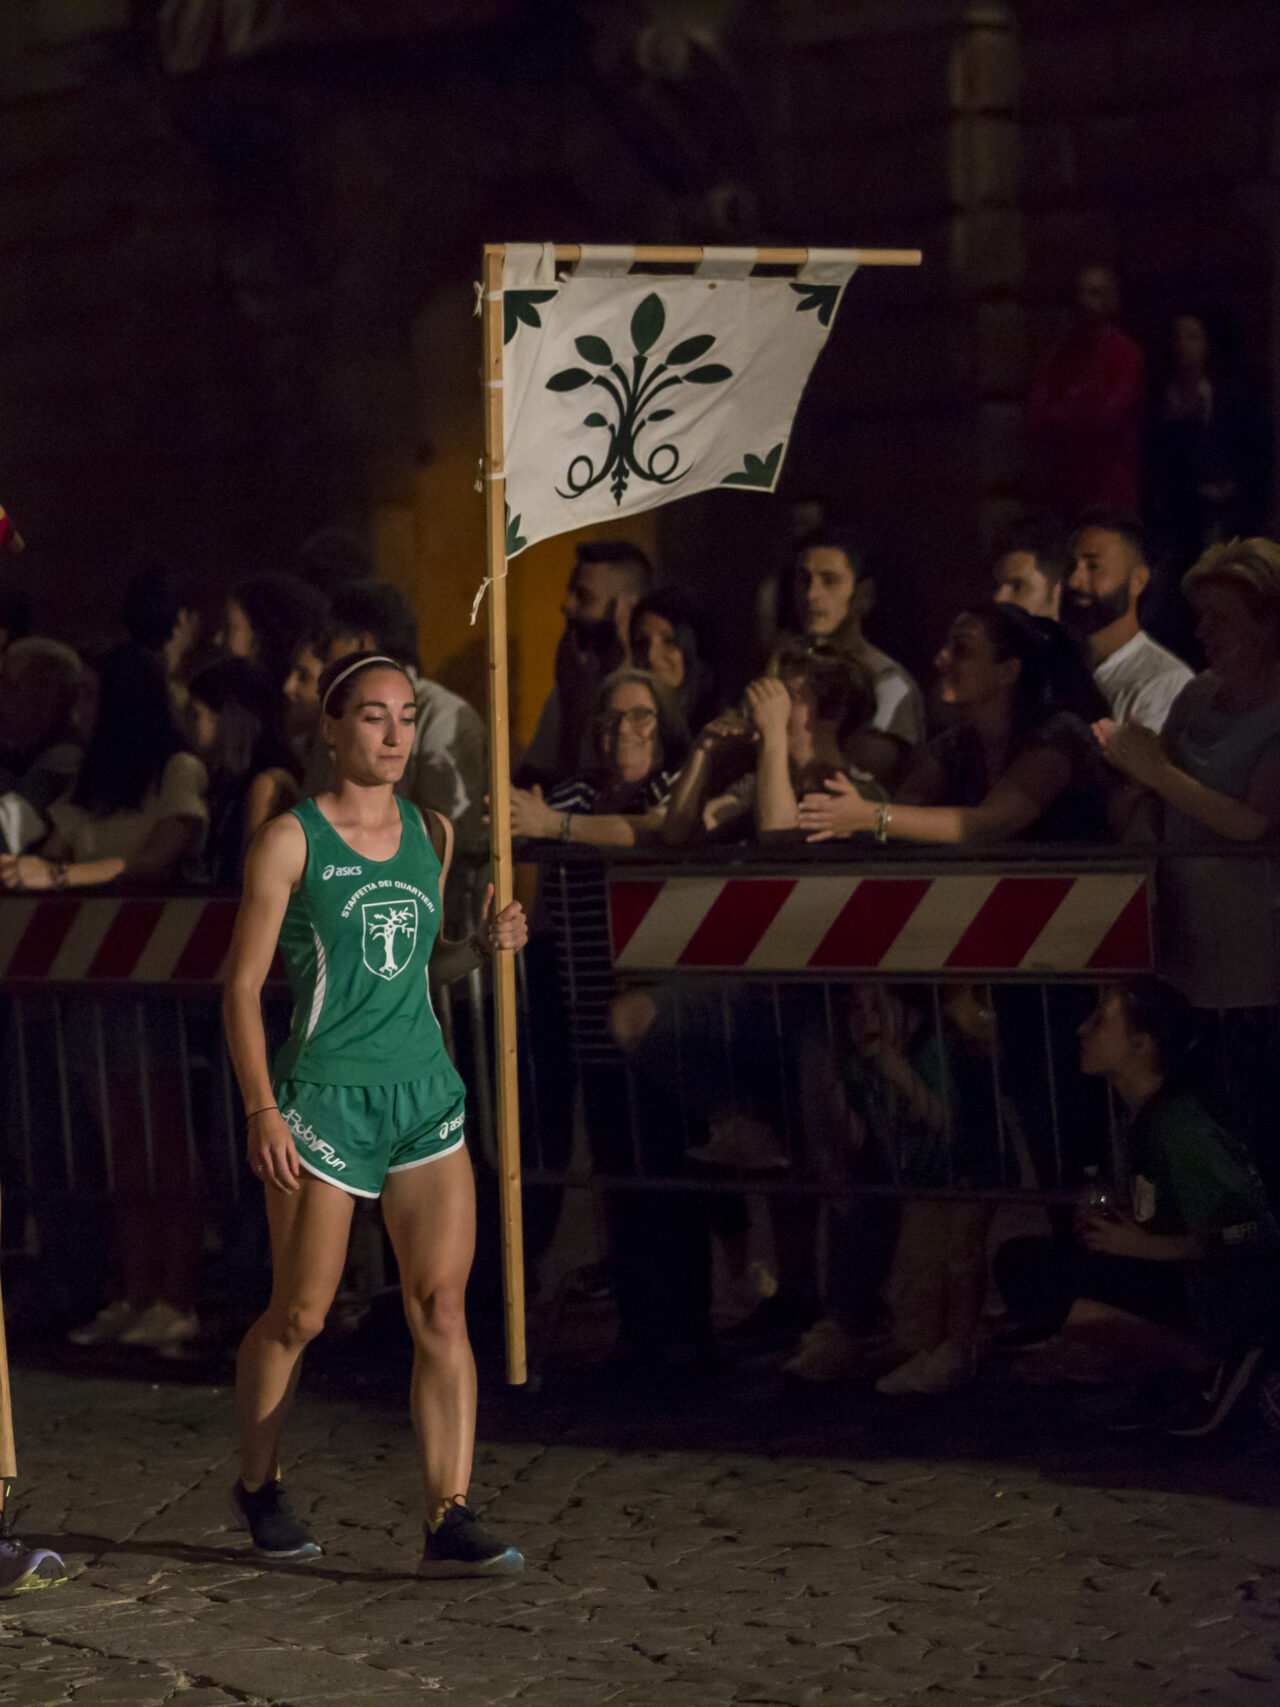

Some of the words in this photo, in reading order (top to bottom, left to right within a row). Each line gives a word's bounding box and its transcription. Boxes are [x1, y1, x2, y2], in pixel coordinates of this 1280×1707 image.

[335, 866, 362, 877] asics
[341, 882, 378, 919] STAFFETTA
[378, 880, 393, 888] DEI
[394, 880, 435, 913] QUARTIERI
